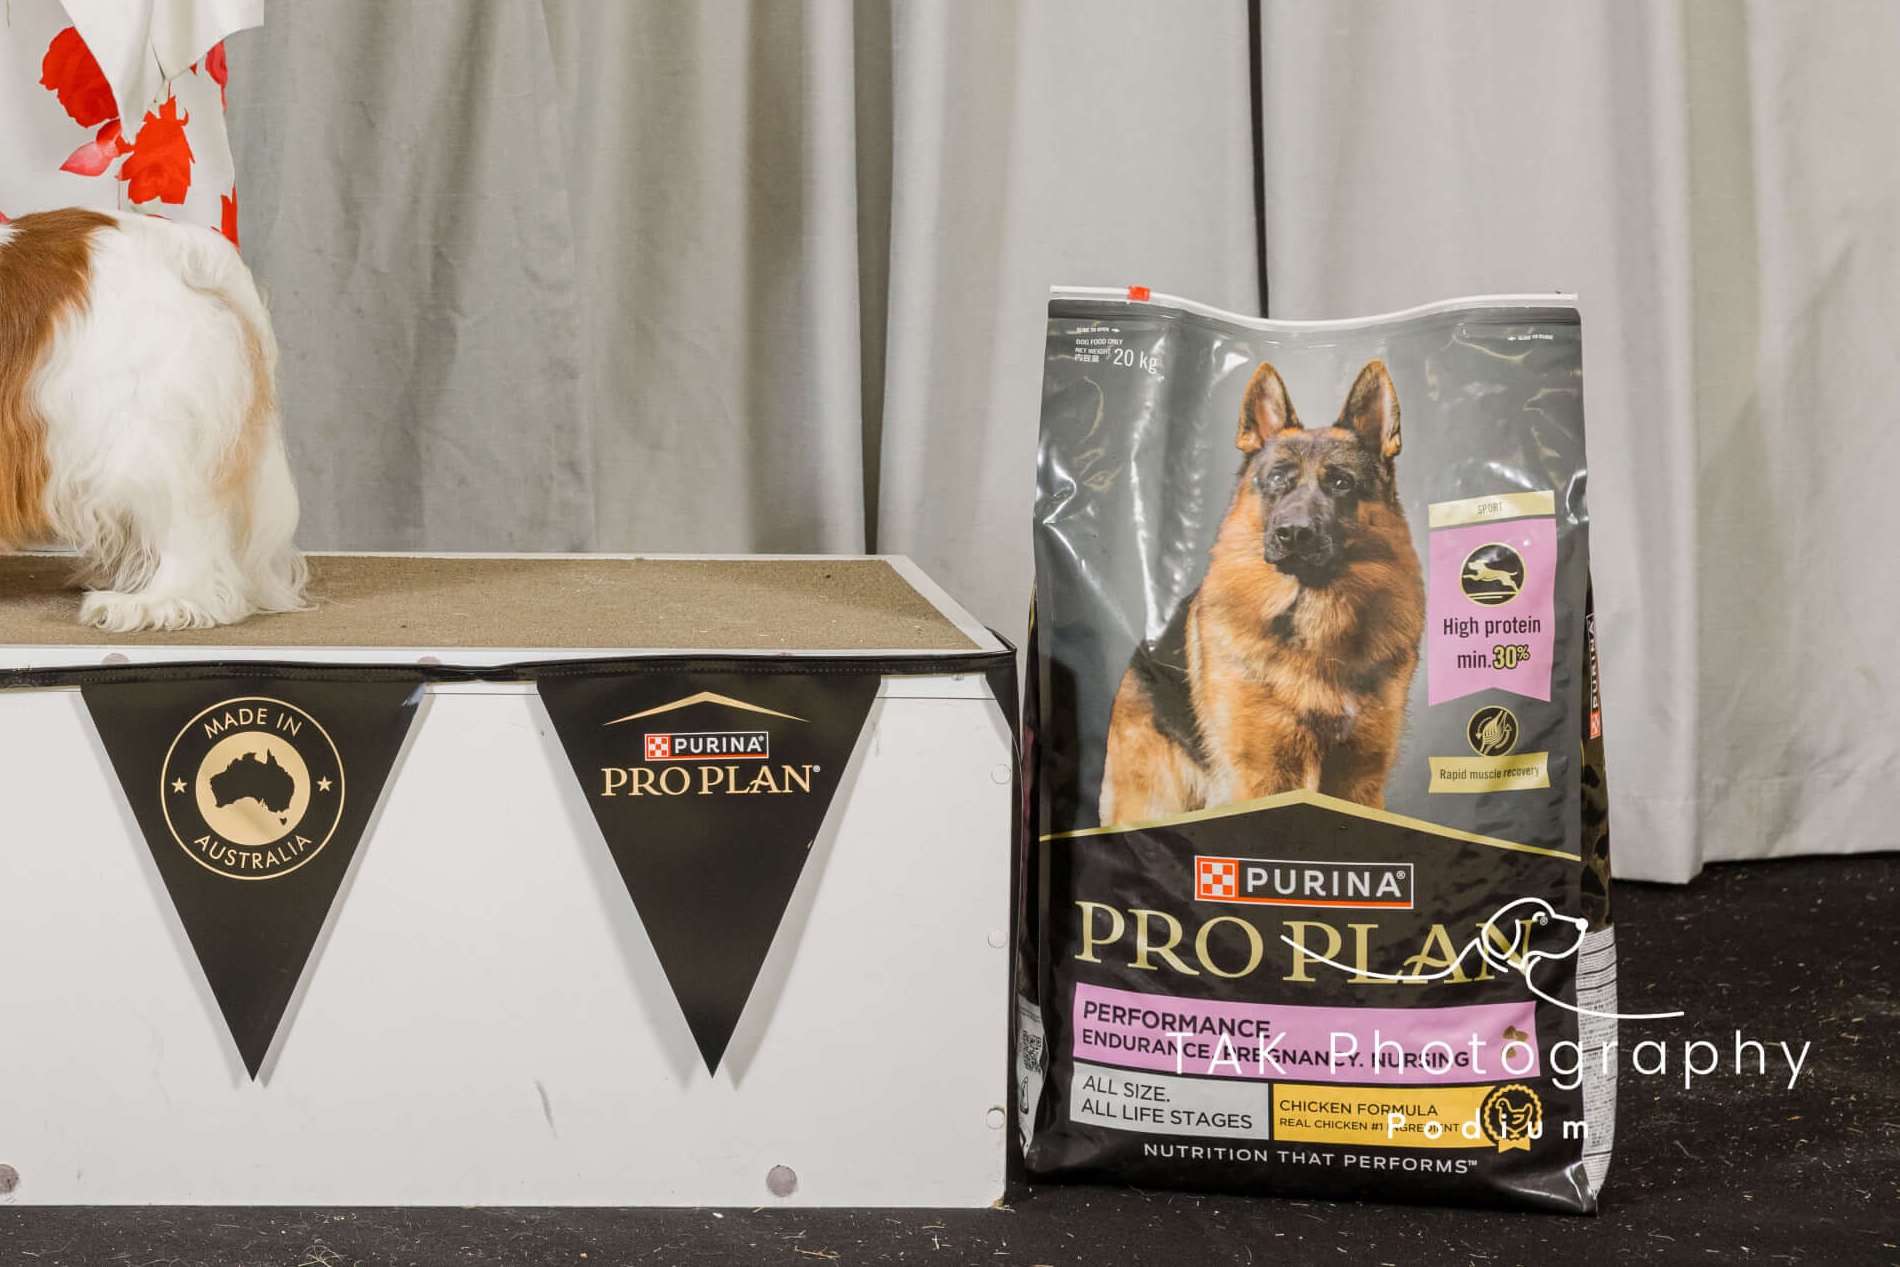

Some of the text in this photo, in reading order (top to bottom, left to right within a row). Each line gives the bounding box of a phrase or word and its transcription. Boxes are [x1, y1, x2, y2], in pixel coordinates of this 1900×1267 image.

[1112, 348, 1158, 374] 20 kg
[1477, 501, 1503, 515] SPORT
[1443, 615, 1541, 638] High protein
[203, 707, 303, 740] MADE IN
[600, 765, 692, 797] PRO
[1440, 766, 1540, 781] Rapid muscle recovery
[194, 834, 313, 870] AUSTRALIA
[1074, 900, 1265, 980] PRO
[1083, 1000, 1271, 1039] PERFORMANCE
[1371, 1051, 1469, 1068] NURSING
[1082, 1075, 1171, 1103] ALL SIZE.
[1080, 1098, 1253, 1129] ALL LIFE STAGES
[1279, 1099, 1438, 1117] CHICKEN FORMULA
[1279, 1118, 1311, 1130] REAL
[1313, 1119, 1368, 1131] CHICKEN
[1370, 1121, 1383, 1132] #1
[1143, 1143, 1268, 1162] NUTRITION
[1277, 1150, 1335, 1167] THAT
